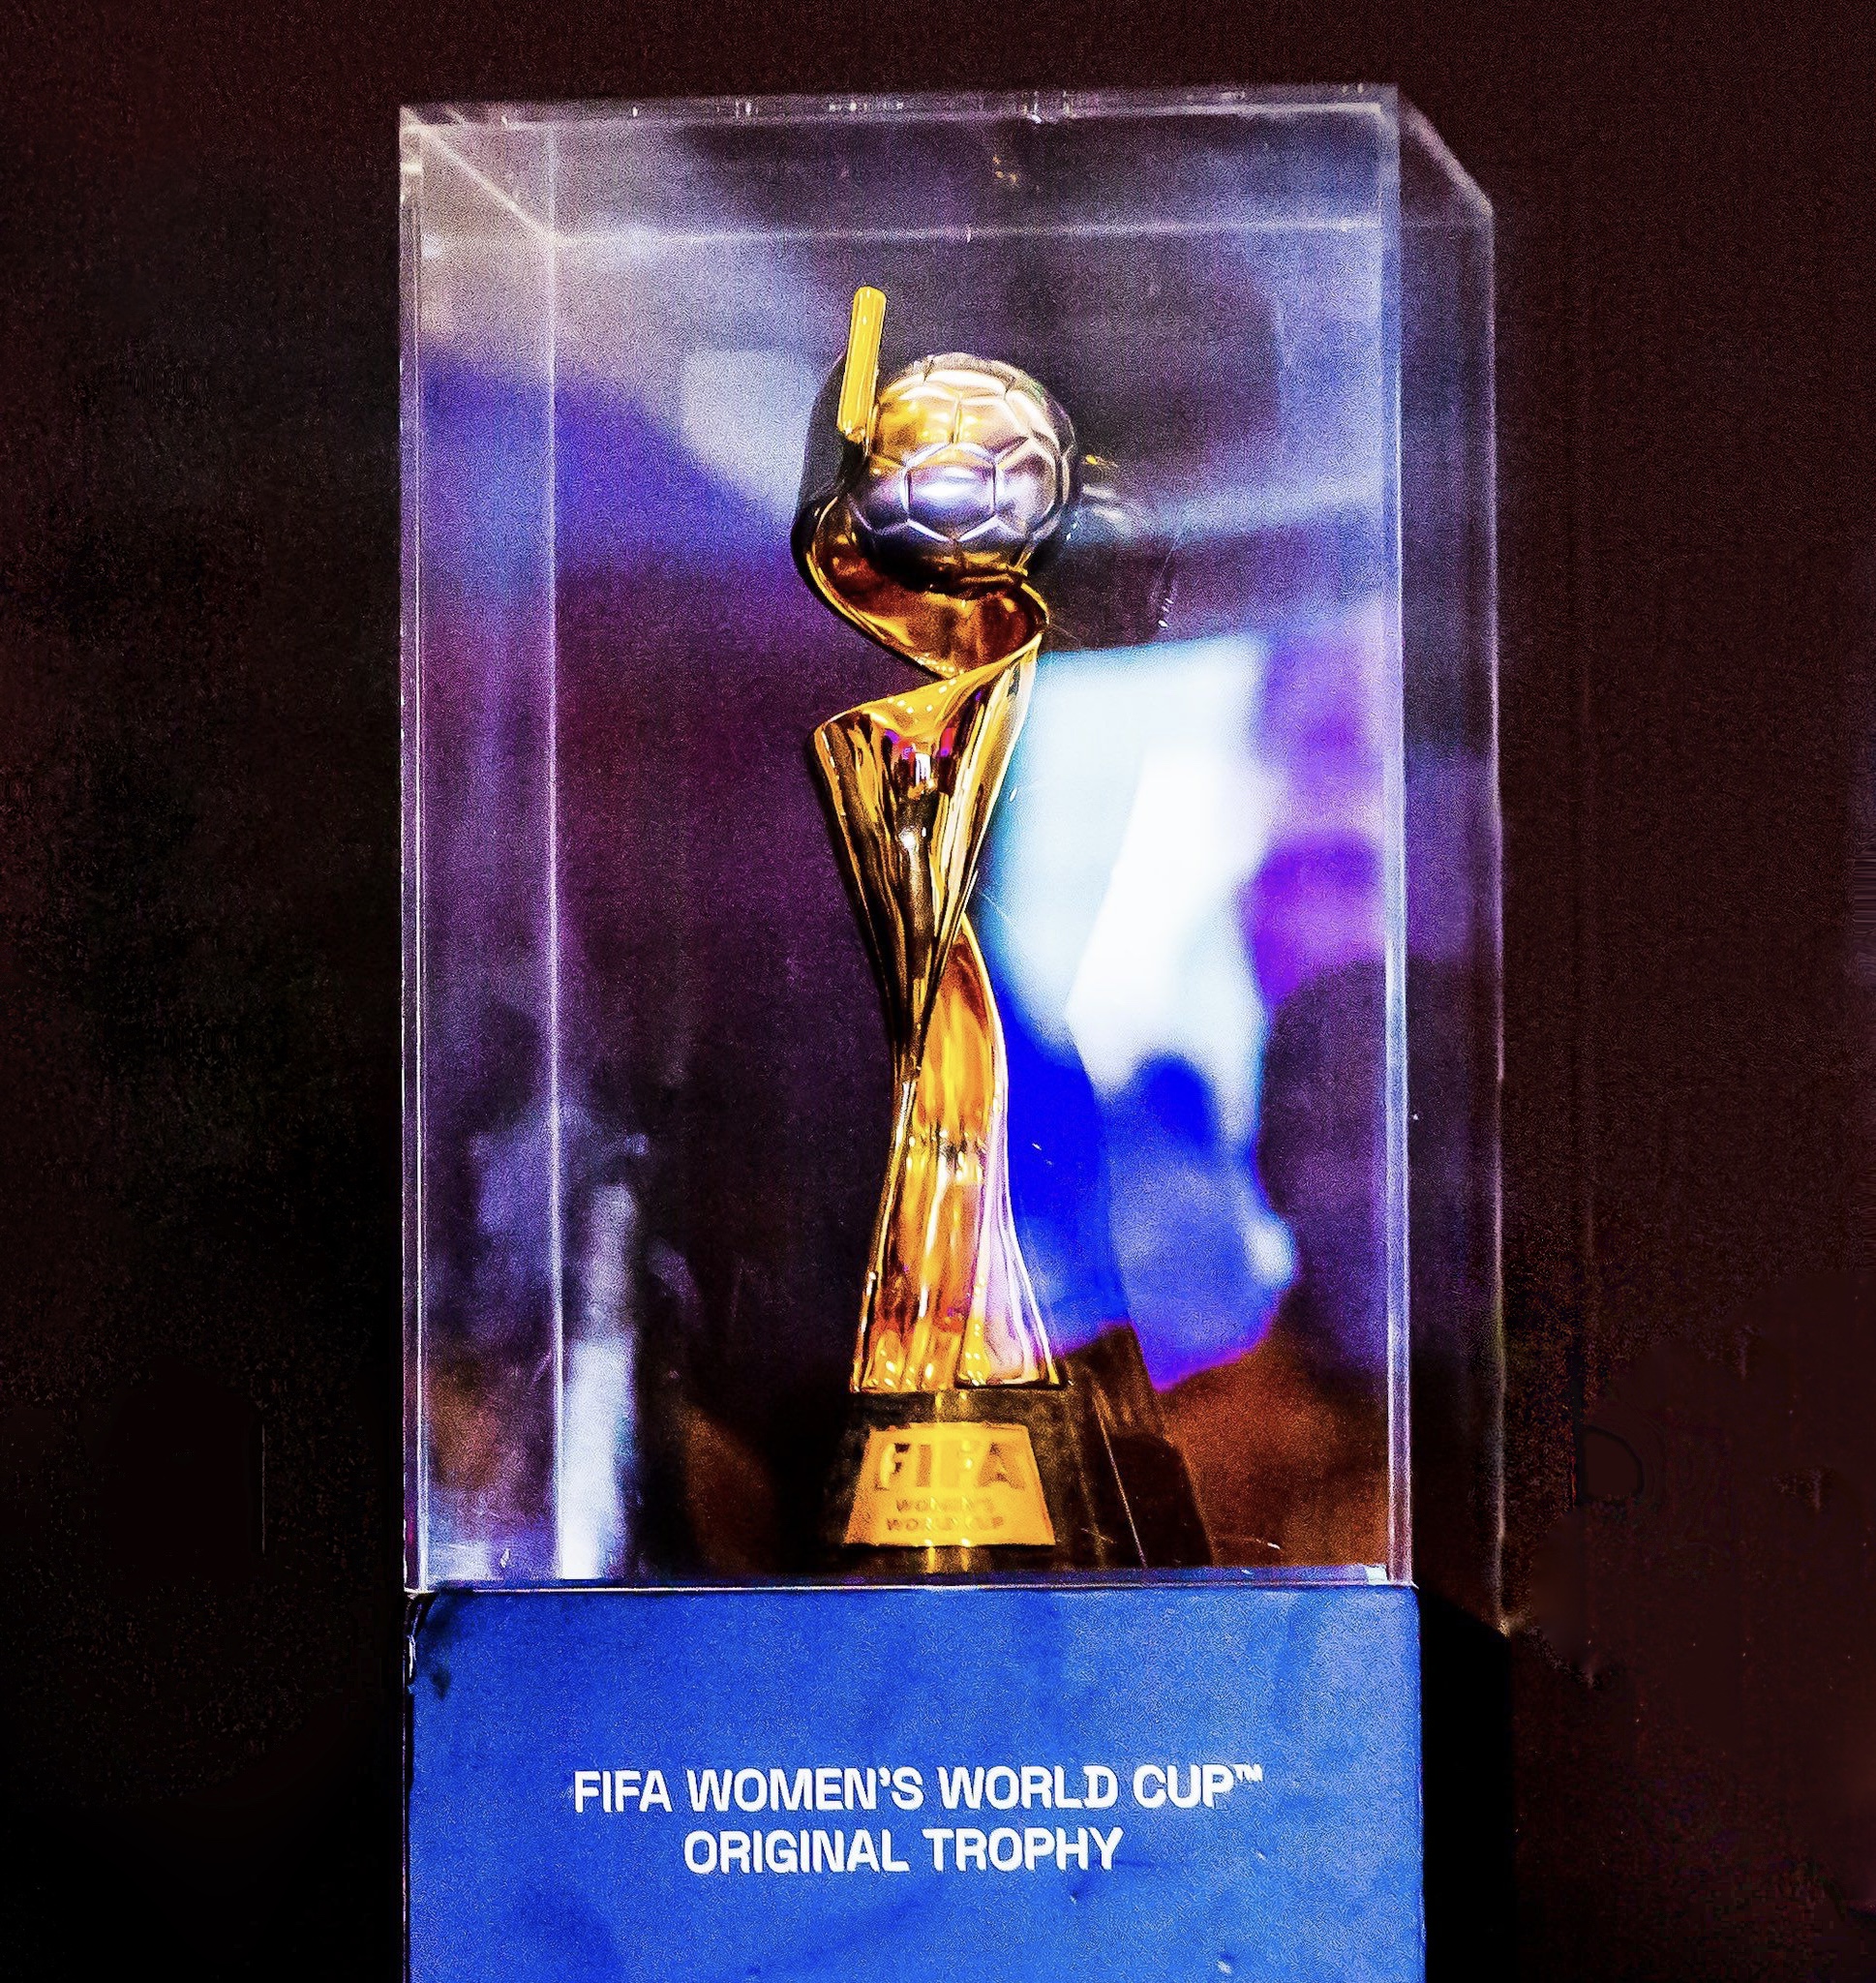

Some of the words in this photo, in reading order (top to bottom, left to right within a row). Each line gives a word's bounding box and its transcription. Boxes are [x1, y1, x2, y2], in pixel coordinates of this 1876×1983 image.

[573, 1769, 673, 1814] FIFA
[686, 1766, 924, 1813] WOMEN'S
[936, 1764, 1119, 1811] WORLD
[683, 1828, 910, 1875] ORIGINAL
[922, 1826, 1125, 1873] TROPHY
